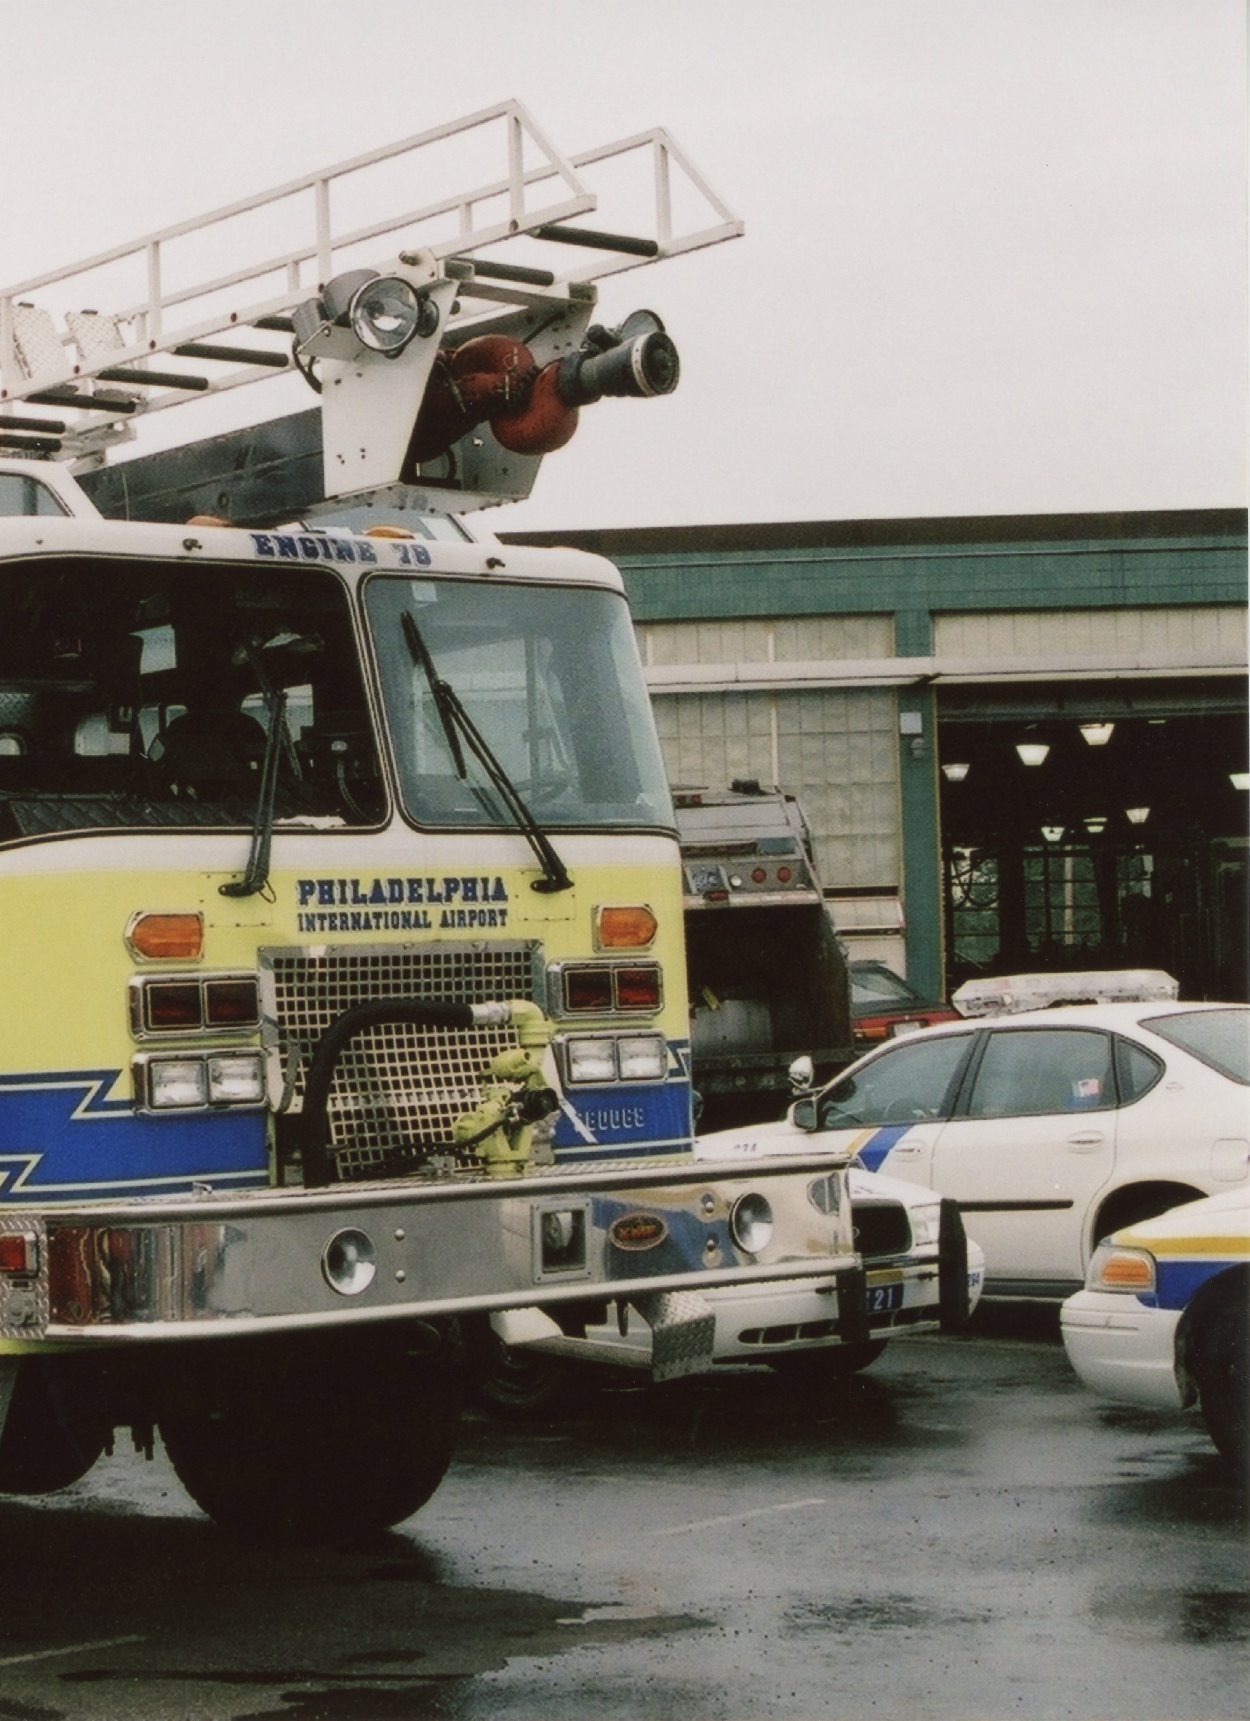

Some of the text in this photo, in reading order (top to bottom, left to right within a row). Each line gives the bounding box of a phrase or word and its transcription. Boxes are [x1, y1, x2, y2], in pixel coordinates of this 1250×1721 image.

[249, 533, 378, 565] ENGINE
[296, 877, 510, 906] PHILADELPHIA
[297, 908, 510, 932] INTERNATIONAL AIRPORT
[865, 1287, 895, 1310] 21
